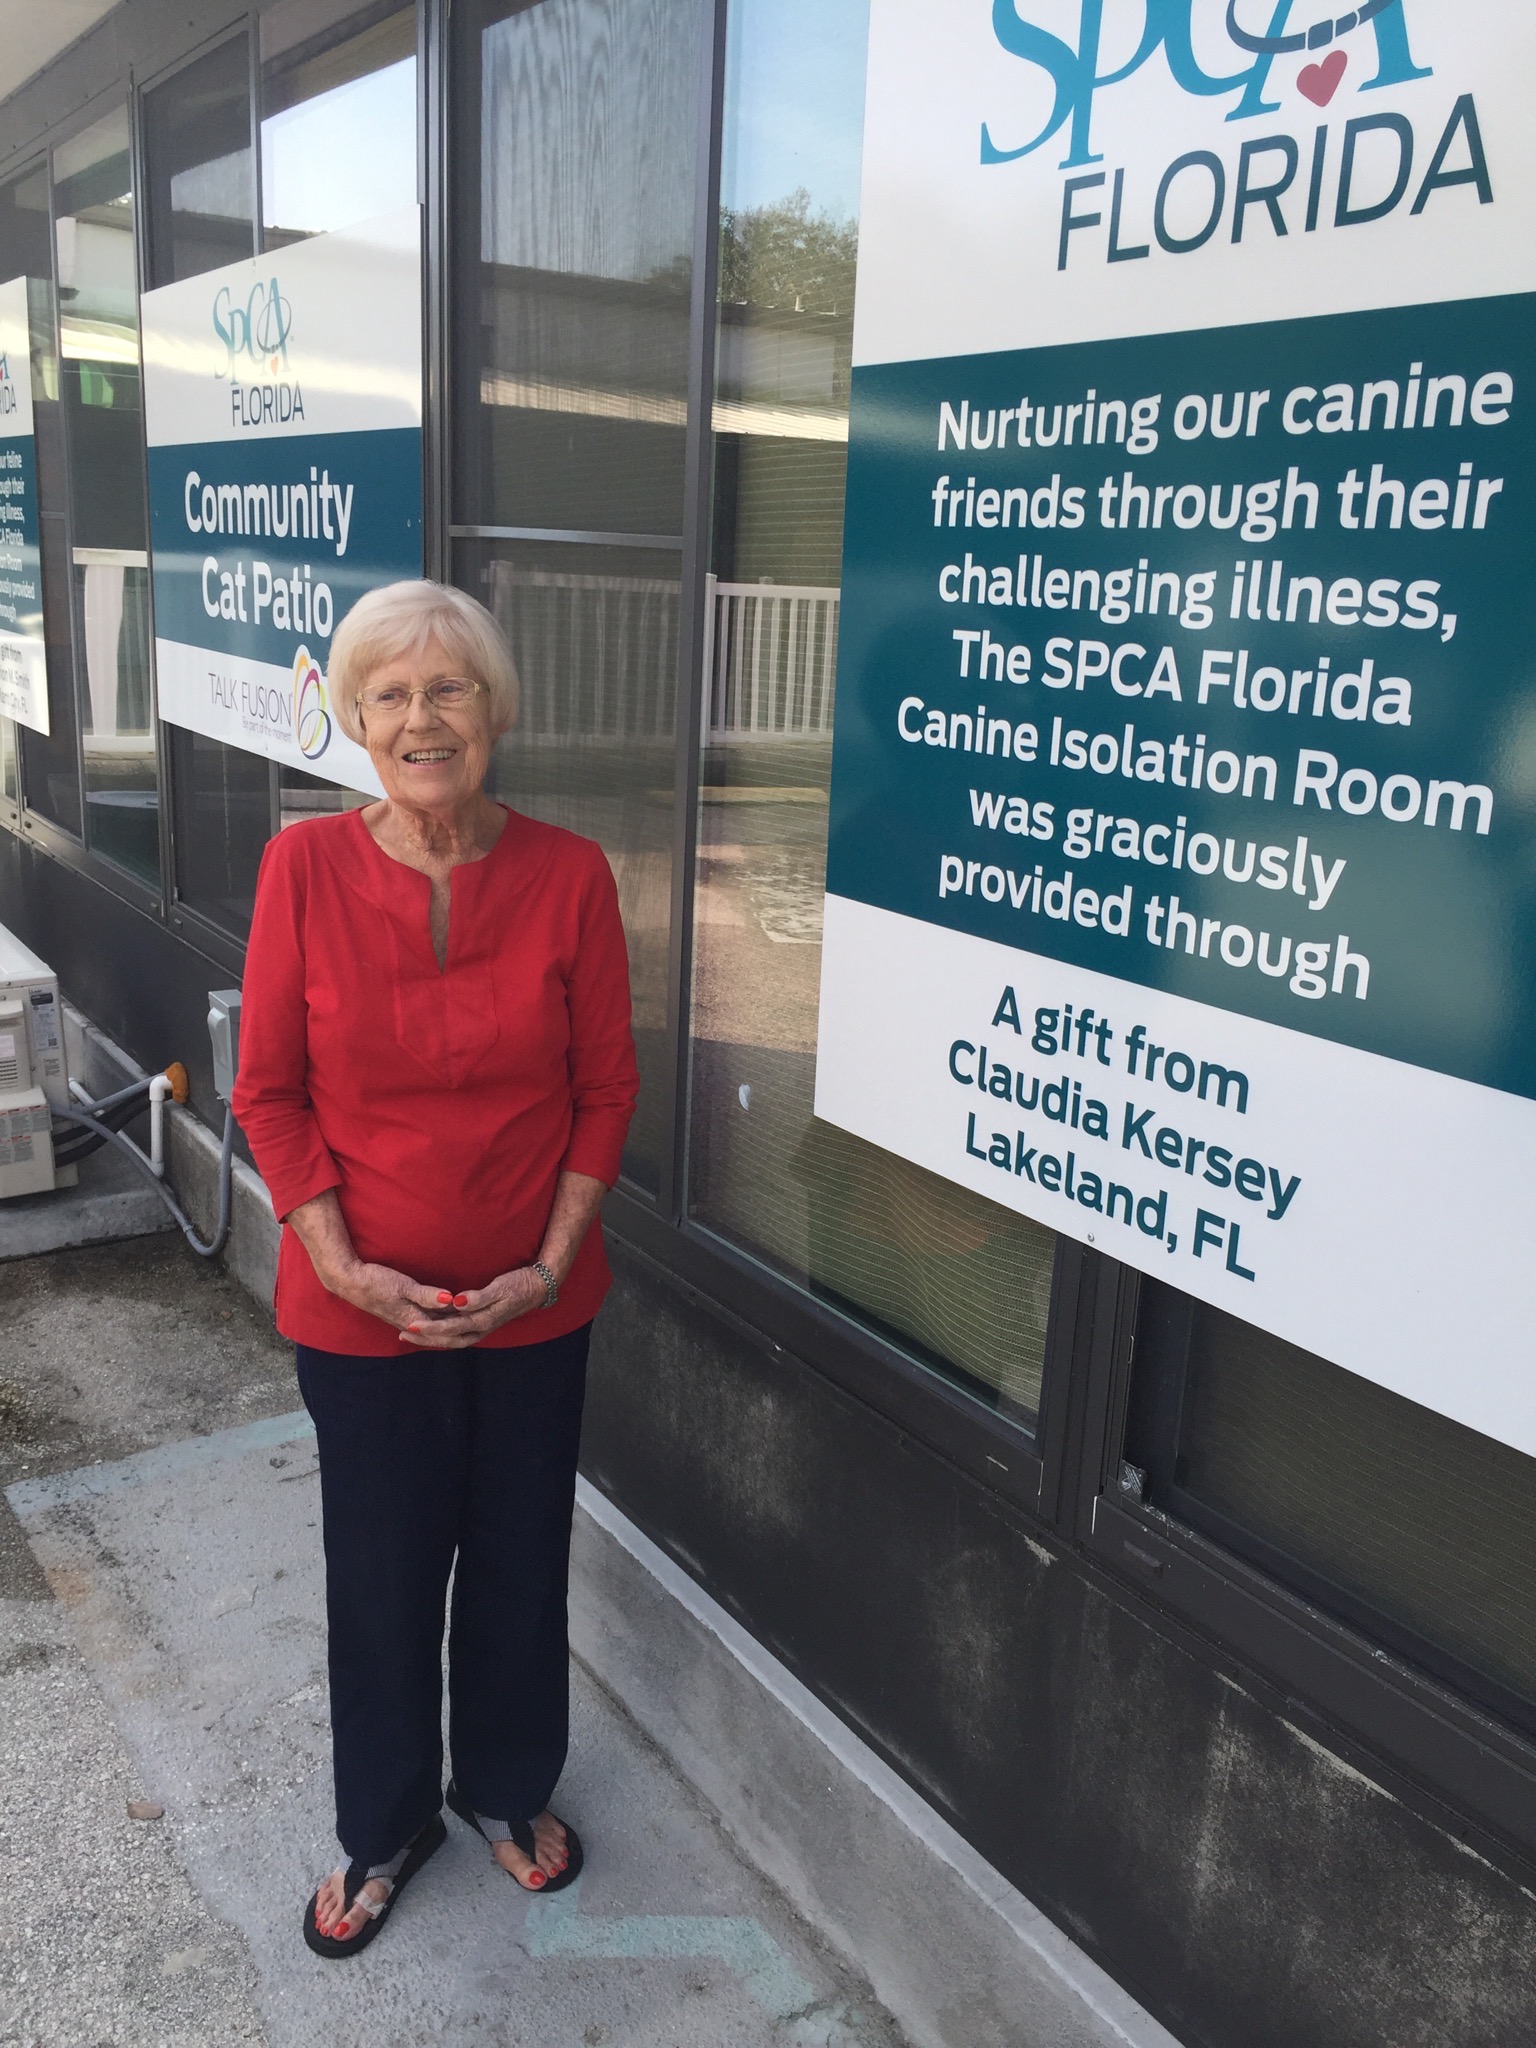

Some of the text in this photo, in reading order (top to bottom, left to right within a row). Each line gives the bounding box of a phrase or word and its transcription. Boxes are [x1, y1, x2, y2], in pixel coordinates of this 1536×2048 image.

[1058, 94, 1493, 270] FLORIDA
[213, 277, 292, 386] SPCA
[231, 379, 305, 427] FLORIDA
[938, 363, 1512, 454] Nurturing our canine
[185, 465, 354, 557] Community
[932, 463, 1503, 541] friends through their
[202, 557, 334, 638] Cat Patio
[940, 554, 1456, 641] challenging illness,
[208, 672, 292, 727] TALK FUSION
[953, 630, 1411, 725] The SPCA Florida
[899, 697, 1493, 834] Canine Isolation Room
[970, 790, 1346, 910] was graciously
[940, 855, 1369, 999] provided through
[992, 986, 1248, 1114] A gift from
[949, 1040, 1301, 1220] Claudia Kersey
[966, 1112, 1255, 1282] Lakeland, FL
